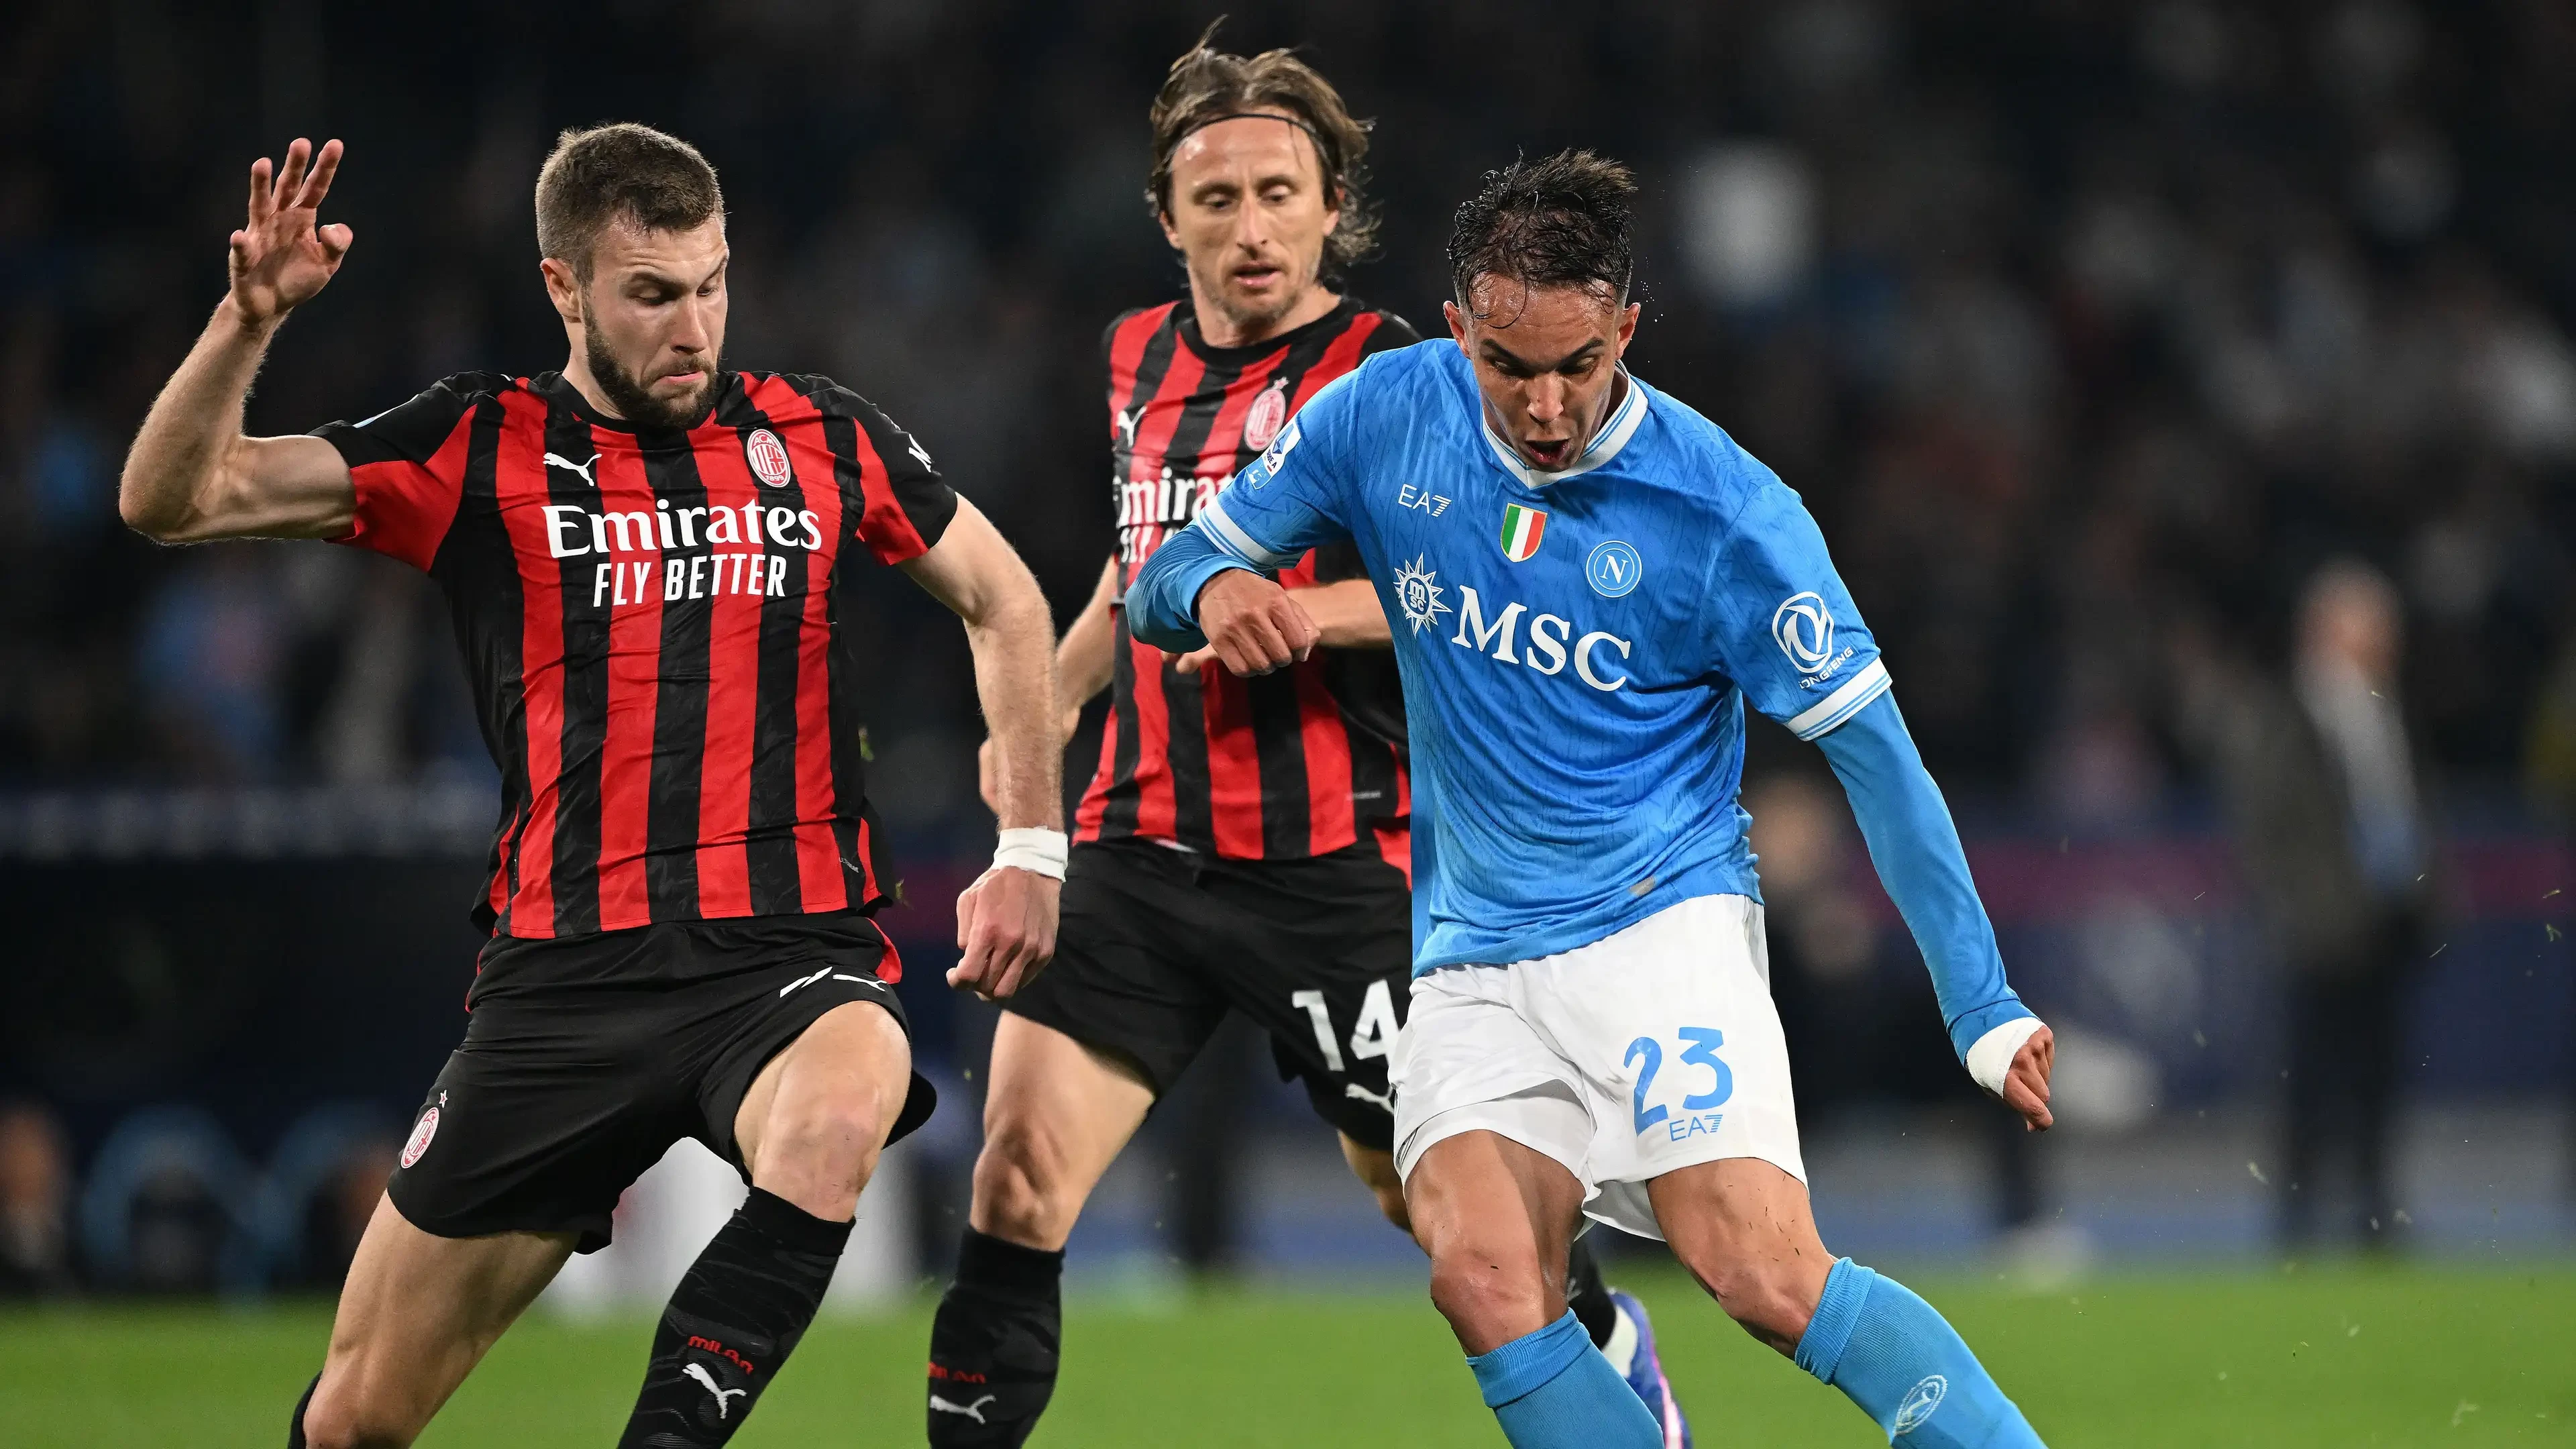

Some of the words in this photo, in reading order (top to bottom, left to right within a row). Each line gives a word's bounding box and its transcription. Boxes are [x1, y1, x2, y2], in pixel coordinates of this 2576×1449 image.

[753, 435, 775, 447] ACM
[1398, 484, 1452, 517] EA7
[541, 498, 822, 559] Emirates
[593, 561, 653, 608] FLY
[664, 553, 787, 602] BETTER
[1601, 554, 1629, 584] N
[1451, 584, 1631, 692] MSC
[1291, 977, 1403, 1071] 14
[1623, 1026, 1733, 1137] 23
[1669, 1114, 1723, 1142] EA7
